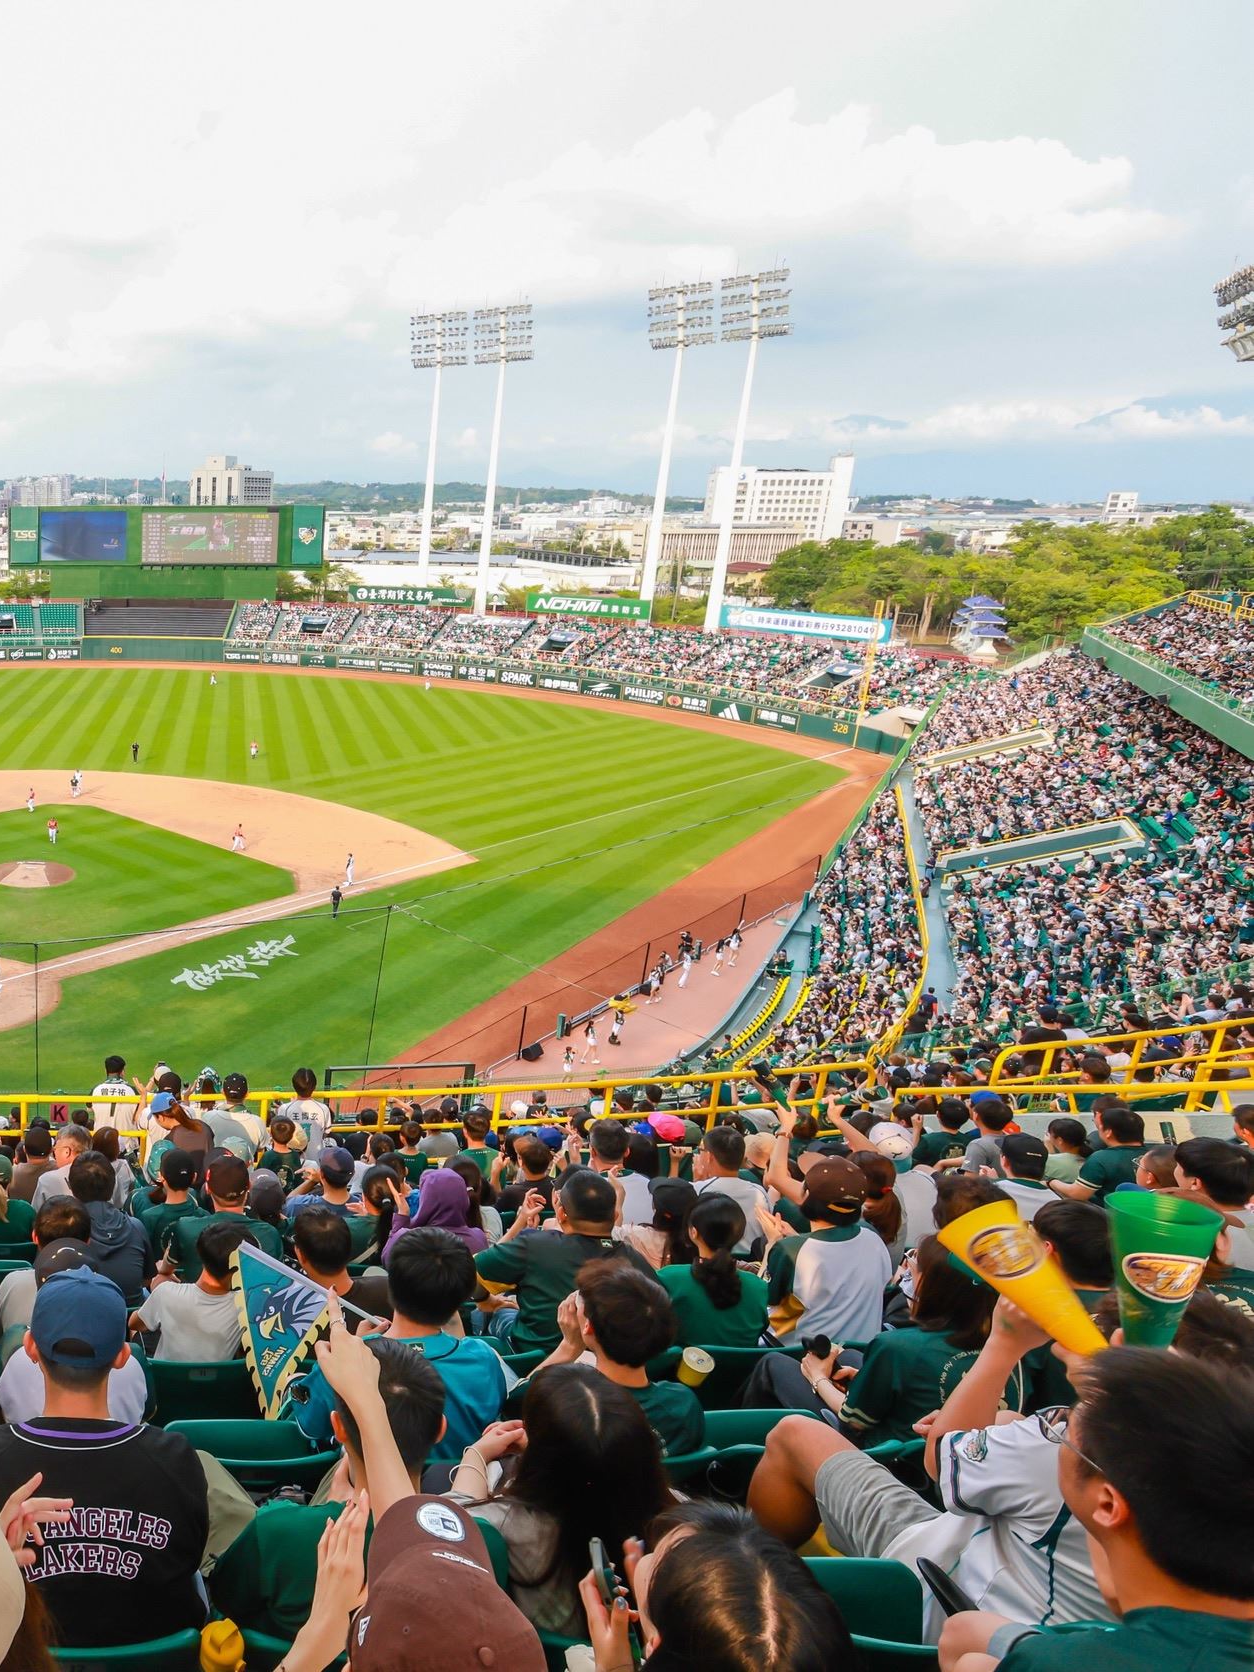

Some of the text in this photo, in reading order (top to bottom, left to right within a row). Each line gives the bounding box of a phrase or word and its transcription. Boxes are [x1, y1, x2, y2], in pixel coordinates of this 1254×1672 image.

[13, 530, 36, 539] TSG
[368, 588, 434, 601] 臺灣期貨交易所
[534, 596, 602, 612] NOHMI
[110, 646, 123, 654] 400
[501, 671, 534, 685] SPARK
[624, 687, 664, 700] PHILIPS
[833, 722, 849, 735] 328
[100, 1088, 126, 1096] 曾子祐
[53, 1105, 65, 1122] K
[292, 1112, 319, 1120] 王博玄
